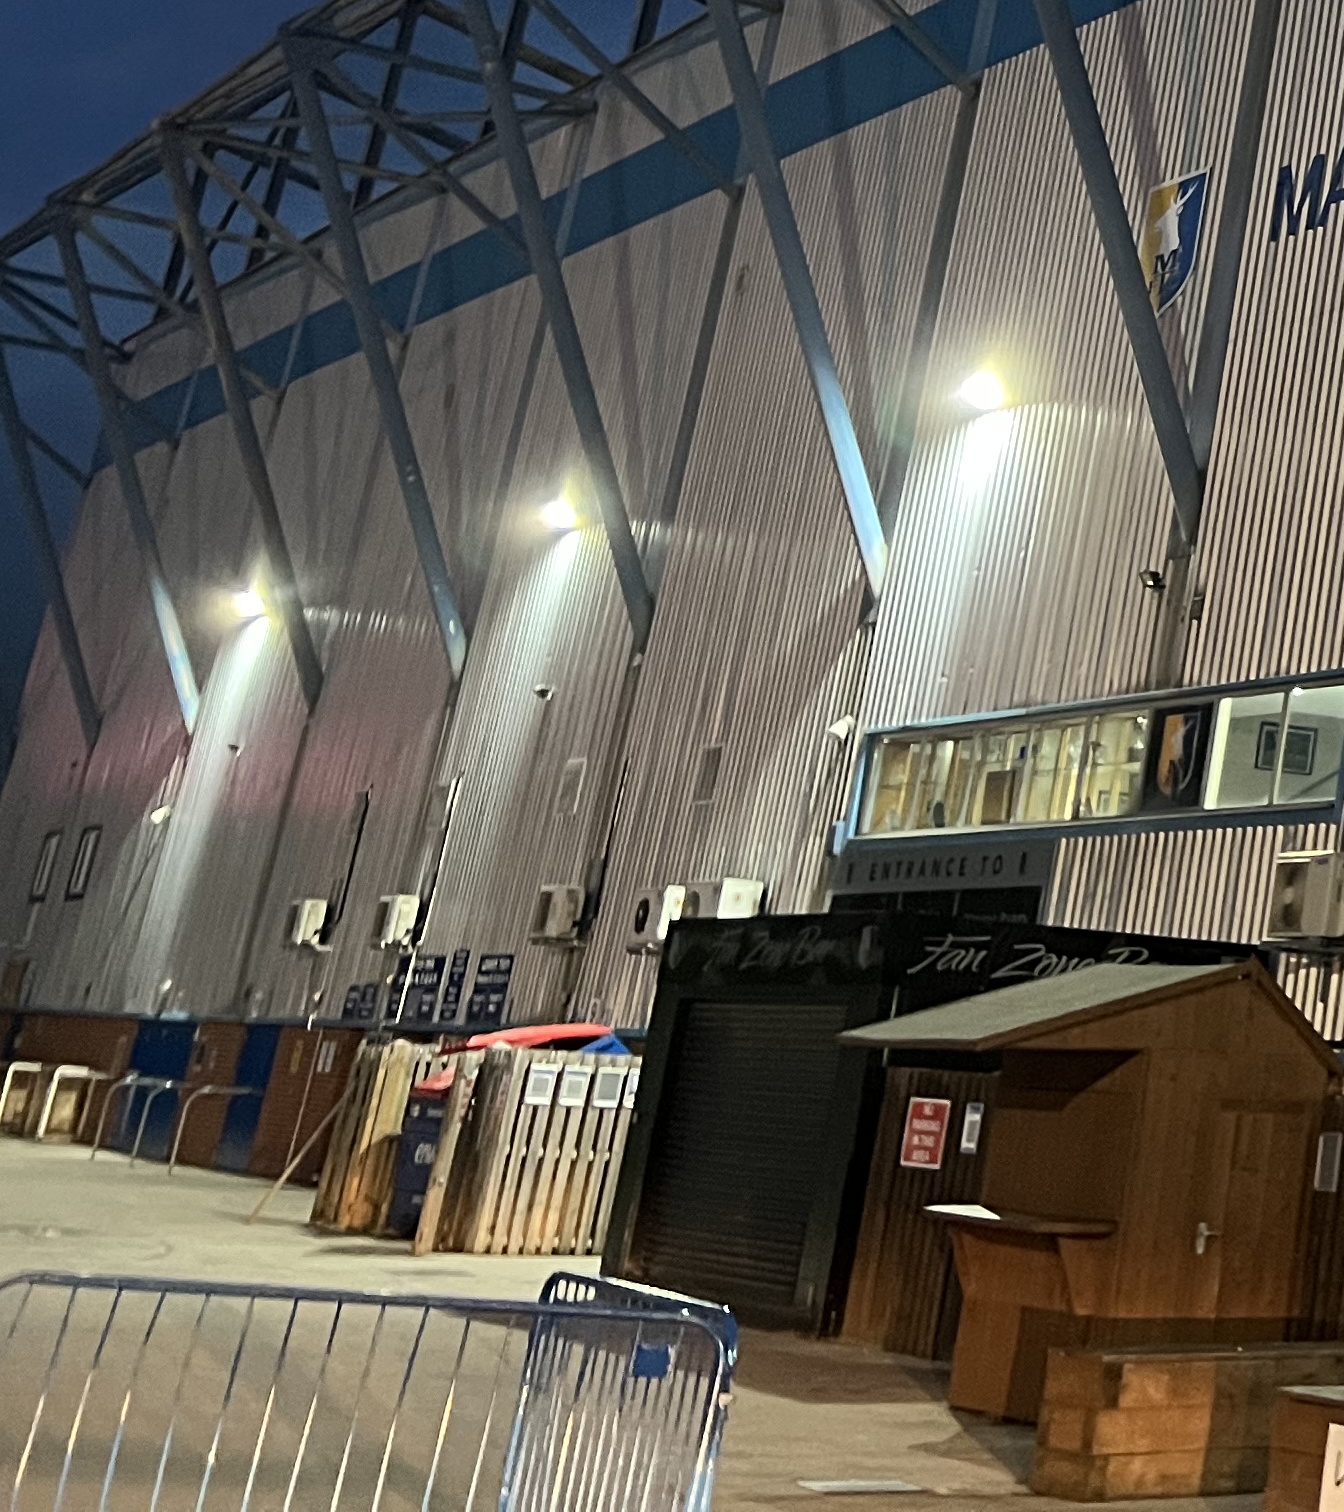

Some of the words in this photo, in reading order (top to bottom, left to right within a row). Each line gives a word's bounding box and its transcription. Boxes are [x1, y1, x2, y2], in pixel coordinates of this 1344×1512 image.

[868, 855, 967, 883] ENTRANCE
[981, 855, 1003, 876] TO
[906, 933, 992, 974] Fan
